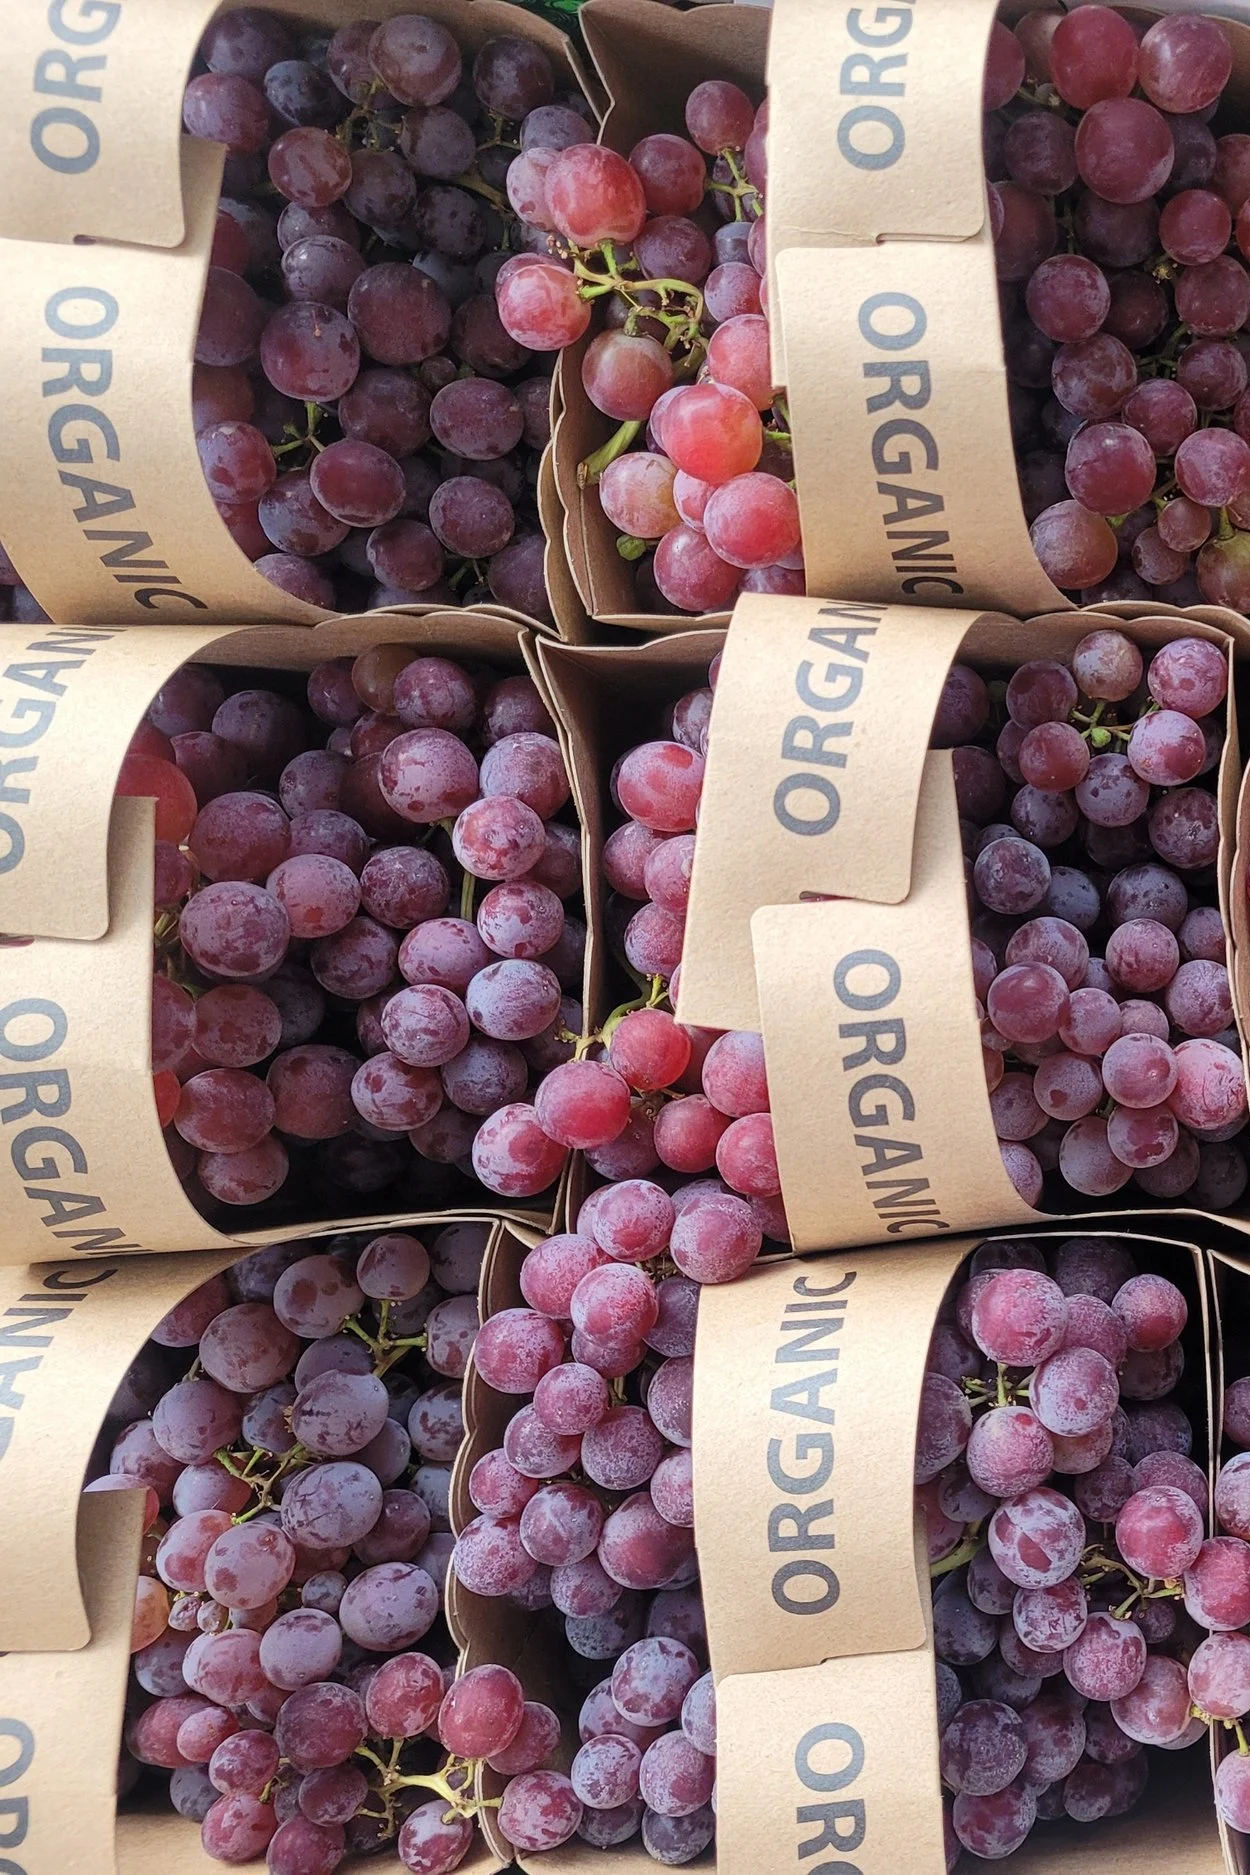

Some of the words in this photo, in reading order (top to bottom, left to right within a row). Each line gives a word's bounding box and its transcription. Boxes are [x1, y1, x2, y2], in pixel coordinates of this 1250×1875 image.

[30, 0, 122, 175] ORG
[837, 0, 916, 171] ORG
[42, 286, 208, 610] ORGANIC
[858, 291, 964, 595] ORGANIC
[833, 949, 950, 1233] ORGANIC
[767, 1271, 857, 1616] ORGANIC
[795, 1722, 866, 1875] OR
